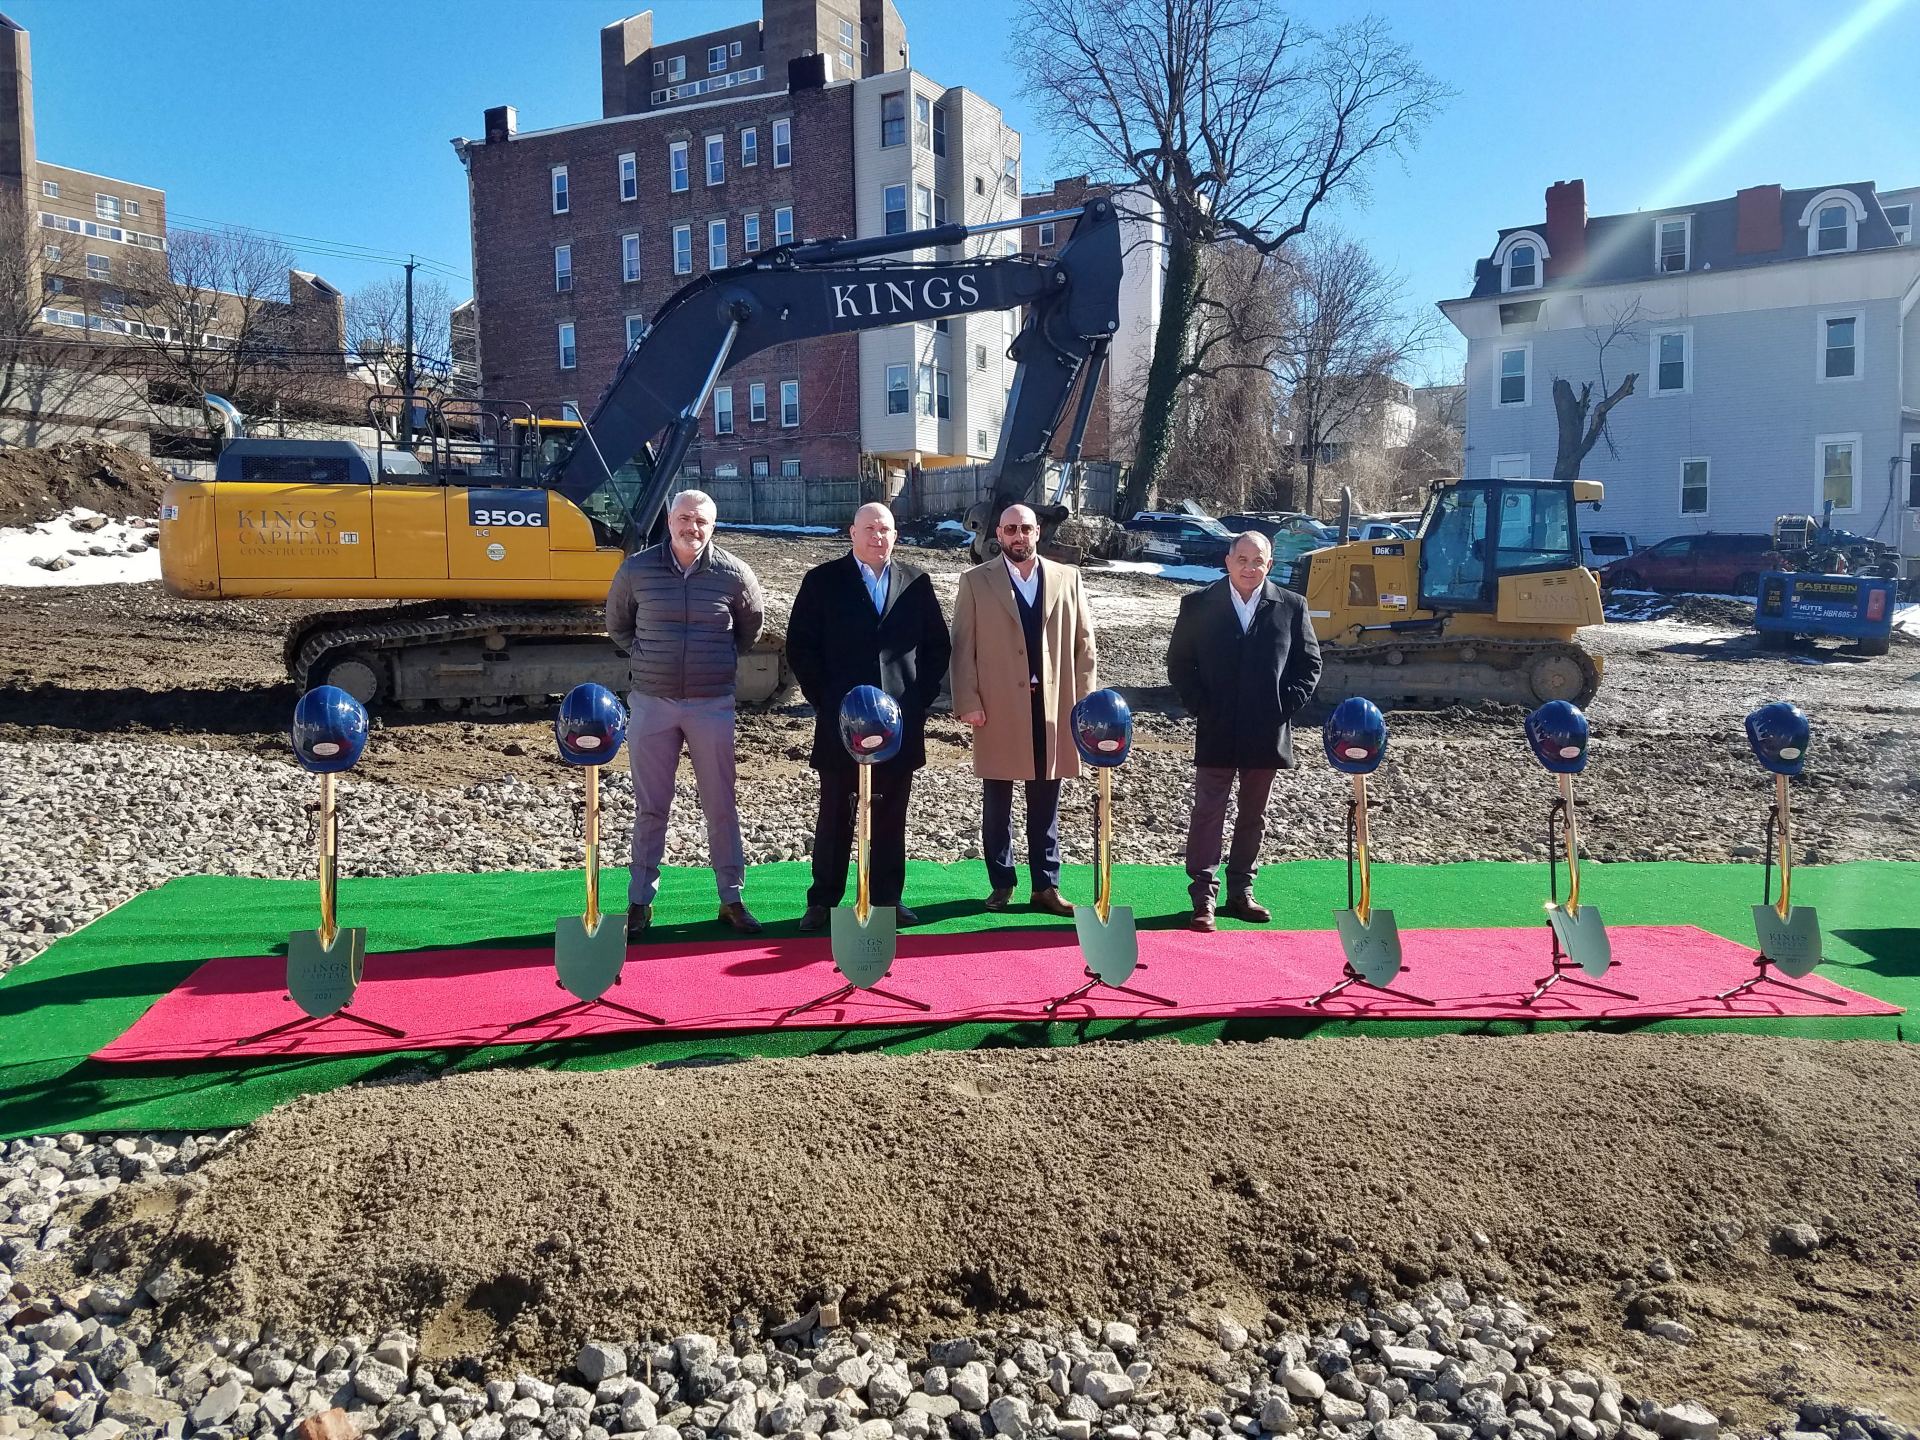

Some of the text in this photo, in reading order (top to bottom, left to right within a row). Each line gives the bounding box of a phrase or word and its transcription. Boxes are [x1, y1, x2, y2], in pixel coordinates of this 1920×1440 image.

[832, 274, 980, 318] KINGS
[238, 510, 337, 529] KINGS
[474, 509, 542, 526] 350G
[238, 531, 339, 545] CAPITAL
[239, 546, 339, 556] CONSTRUCTION
[1795, 582, 1858, 591] EASTERN
[1799, 604, 1823, 612] HÜTTE
[1769, 933, 1808, 942] KINGS
